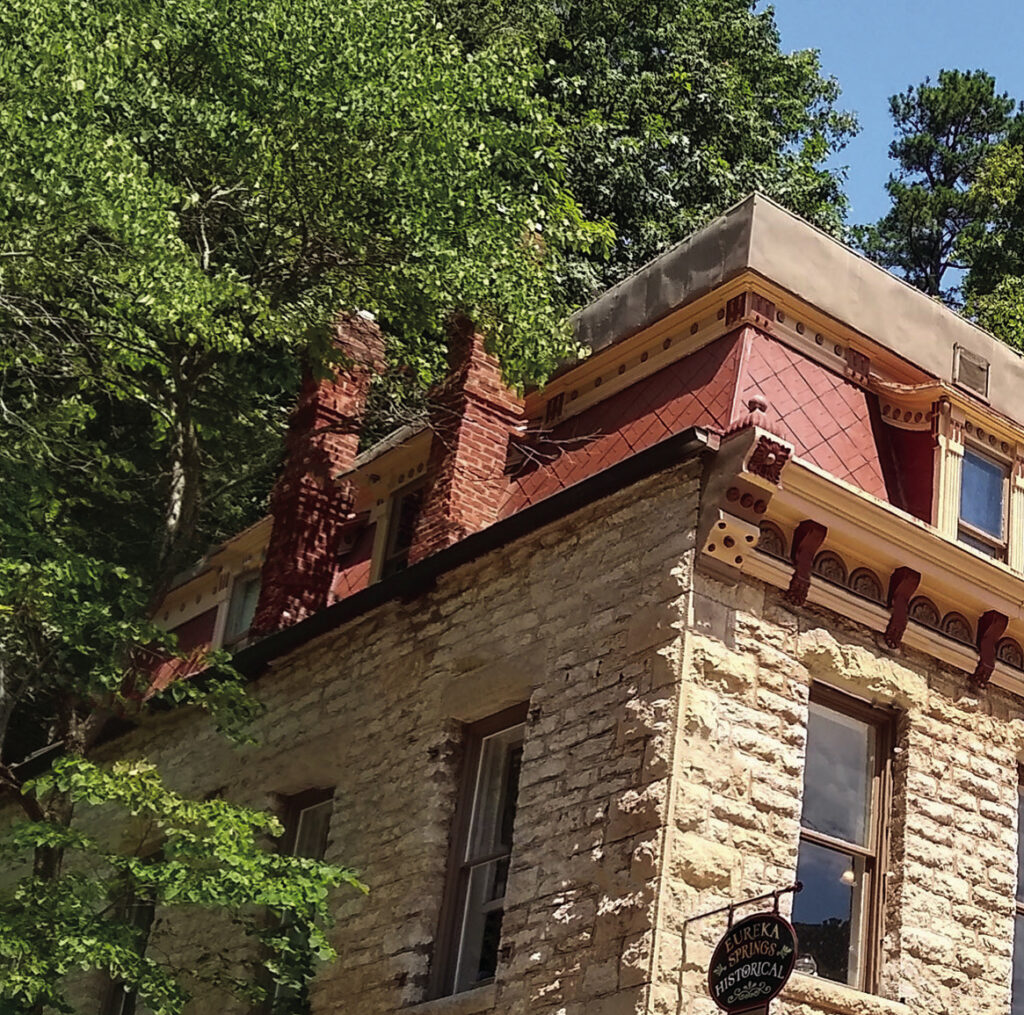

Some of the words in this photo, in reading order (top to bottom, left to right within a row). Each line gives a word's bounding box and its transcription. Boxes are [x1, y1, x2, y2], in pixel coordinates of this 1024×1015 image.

[724, 922, 780, 953] EUREKA
[728, 940, 777, 967] SPRINGS
[714, 961, 785, 997] HISTORICAL
